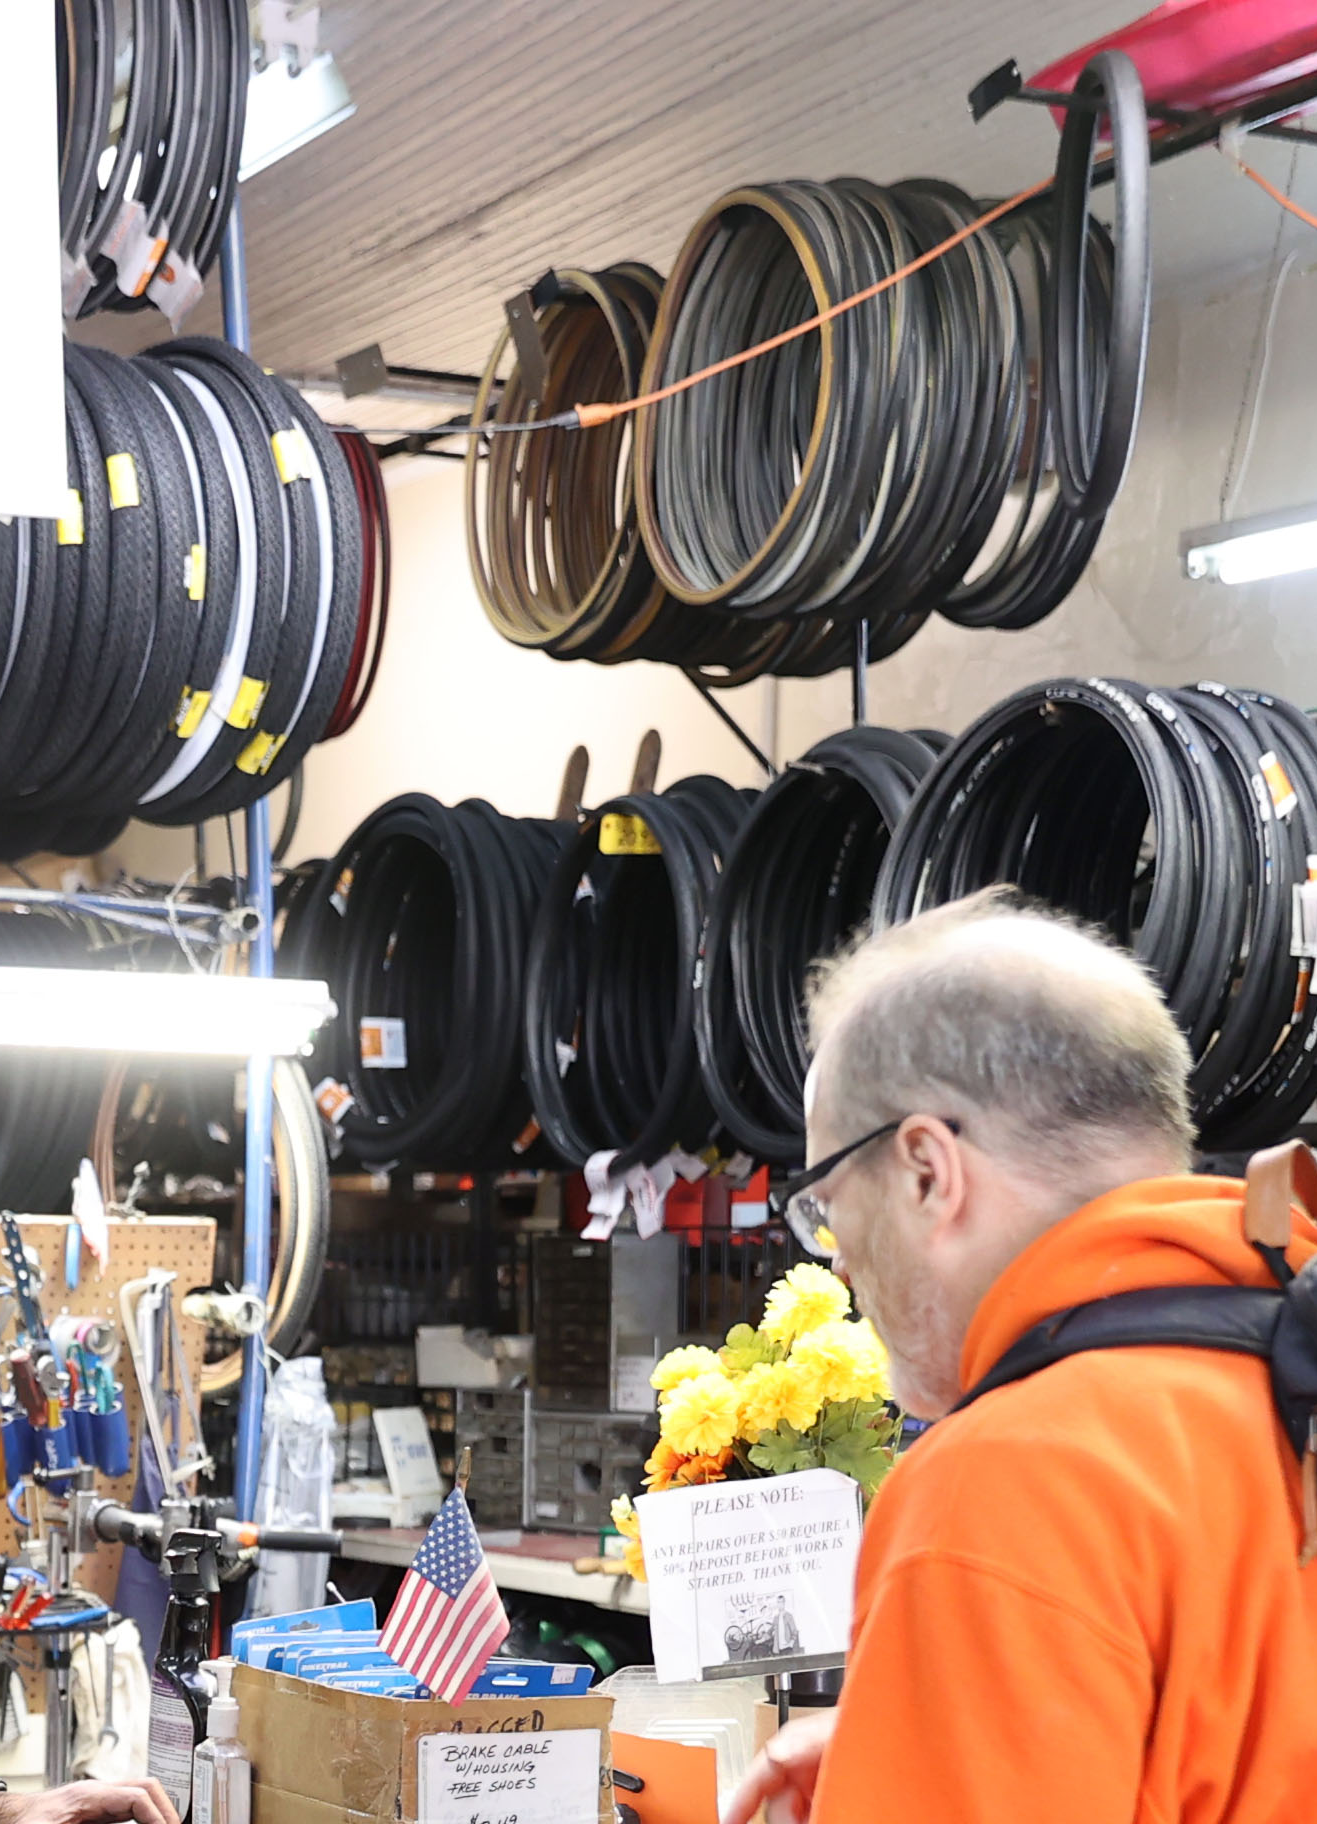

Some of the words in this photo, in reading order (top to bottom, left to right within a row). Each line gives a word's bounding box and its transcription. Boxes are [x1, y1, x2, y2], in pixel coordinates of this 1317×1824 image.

[692, 1492, 755, 1517] PLEASE
[759, 1484, 805, 1505] NOTE:
[678, 1537, 732, 1556] REPAIRS
[733, 1530, 766, 1549] OVER
[789, 1518, 842, 1540] REQUIRE
[688, 1552, 742, 1574] DEPOSIT
[743, 1545, 792, 1565] BEFORE
[794, 1540, 830, 1557] WORK
[831, 1536, 844, 1549] IS
[687, 1572, 747, 1591] STARTED.
[752, 1562, 793, 1581] THANK
[440, 1744, 498, 1762] BRAKE
[502, 1739, 553, 1755] CABLE
[446, 1781, 483, 1796] FREE
[487, 1777, 537, 1794] SHOES
